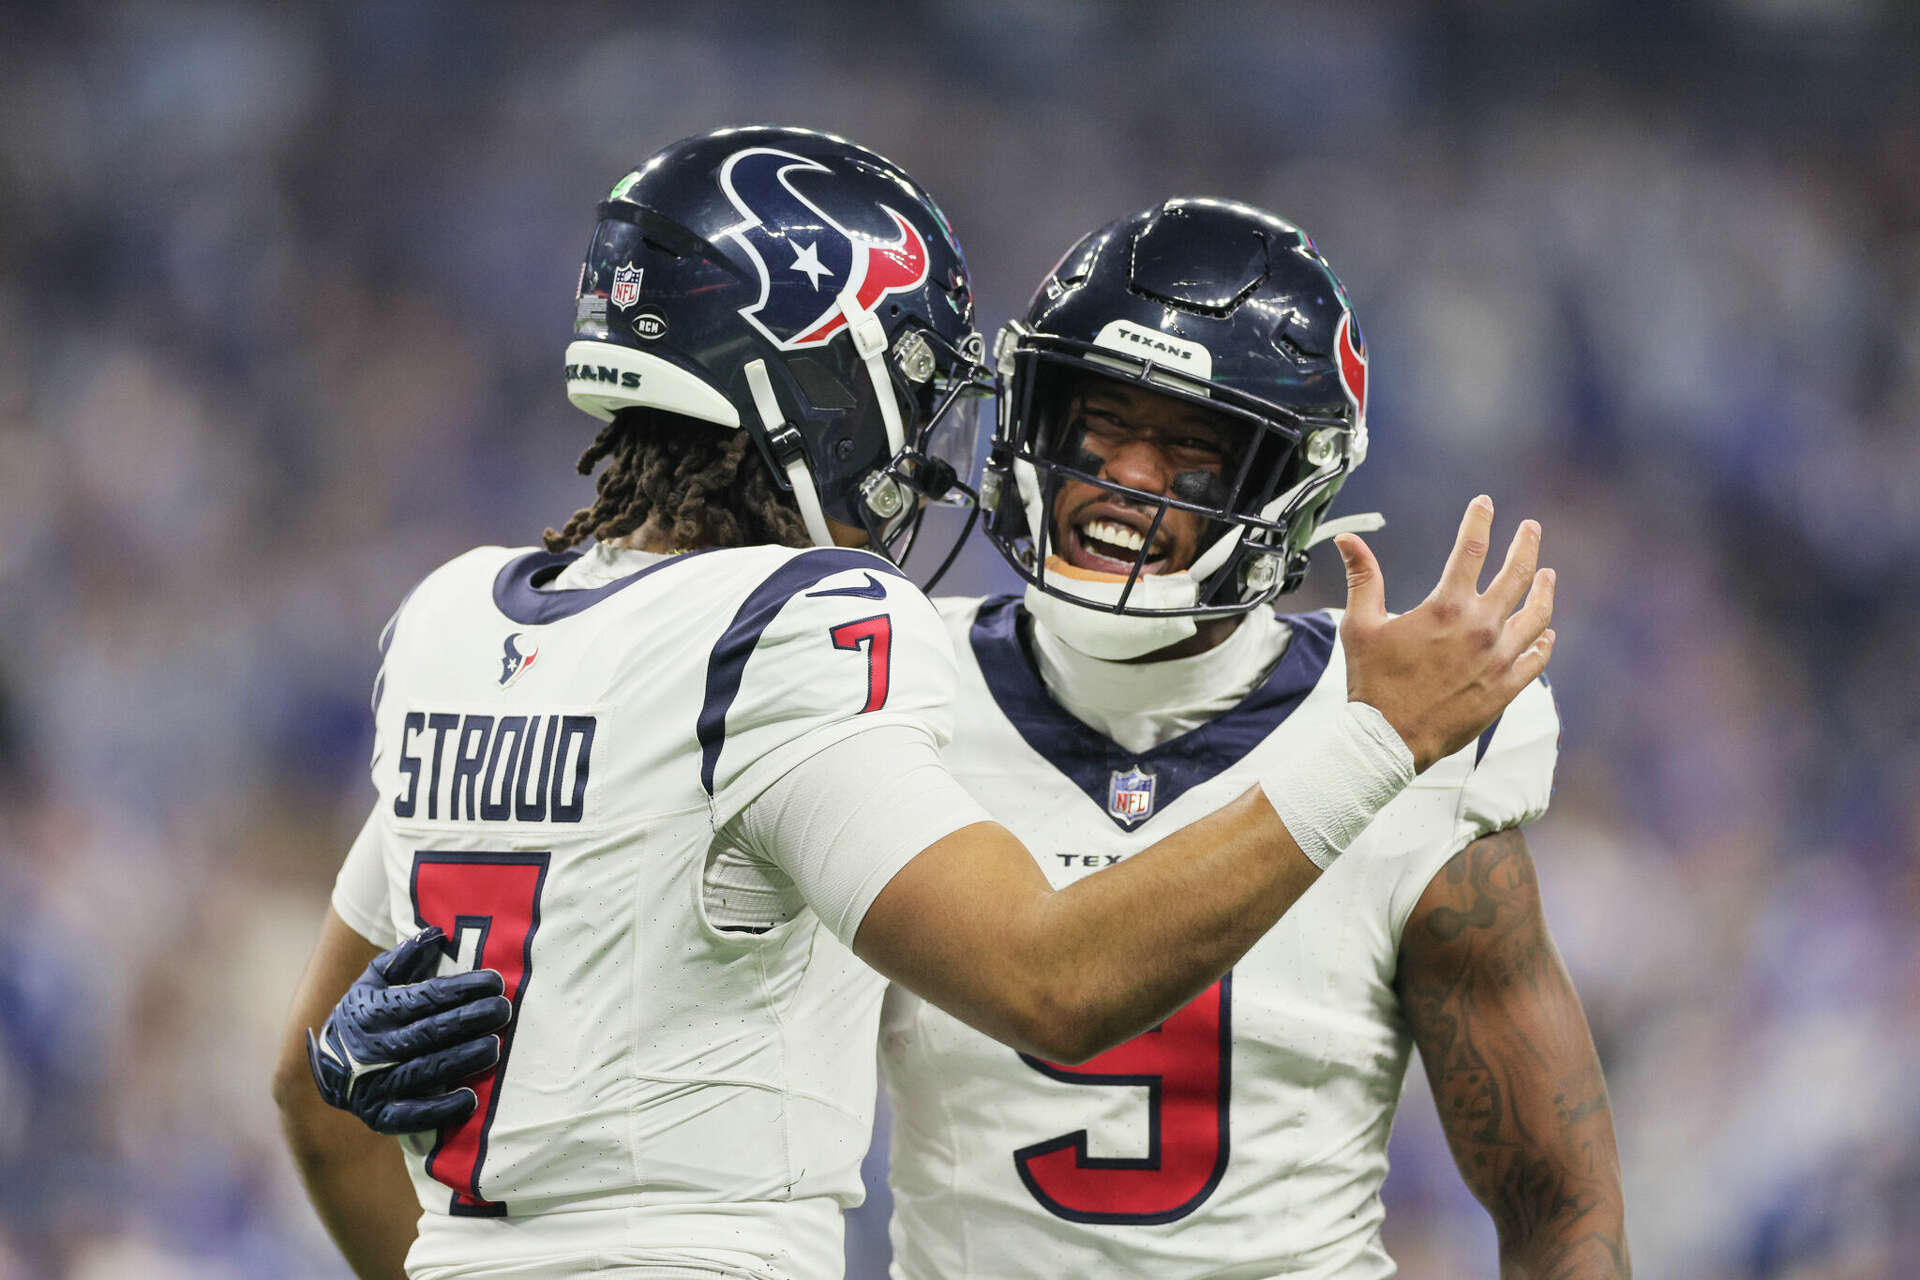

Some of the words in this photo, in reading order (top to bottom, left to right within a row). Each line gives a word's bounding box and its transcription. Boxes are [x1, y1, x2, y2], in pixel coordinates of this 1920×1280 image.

[615, 283, 636, 303] NFL
[1118, 328, 1192, 360] TEXANS
[565, 364, 642, 388] XANS
[829, 613, 892, 715] 7
[393, 711, 597, 823] STROUD
[1115, 792, 1146, 814] NFL
[409, 850, 552, 1217] 7
